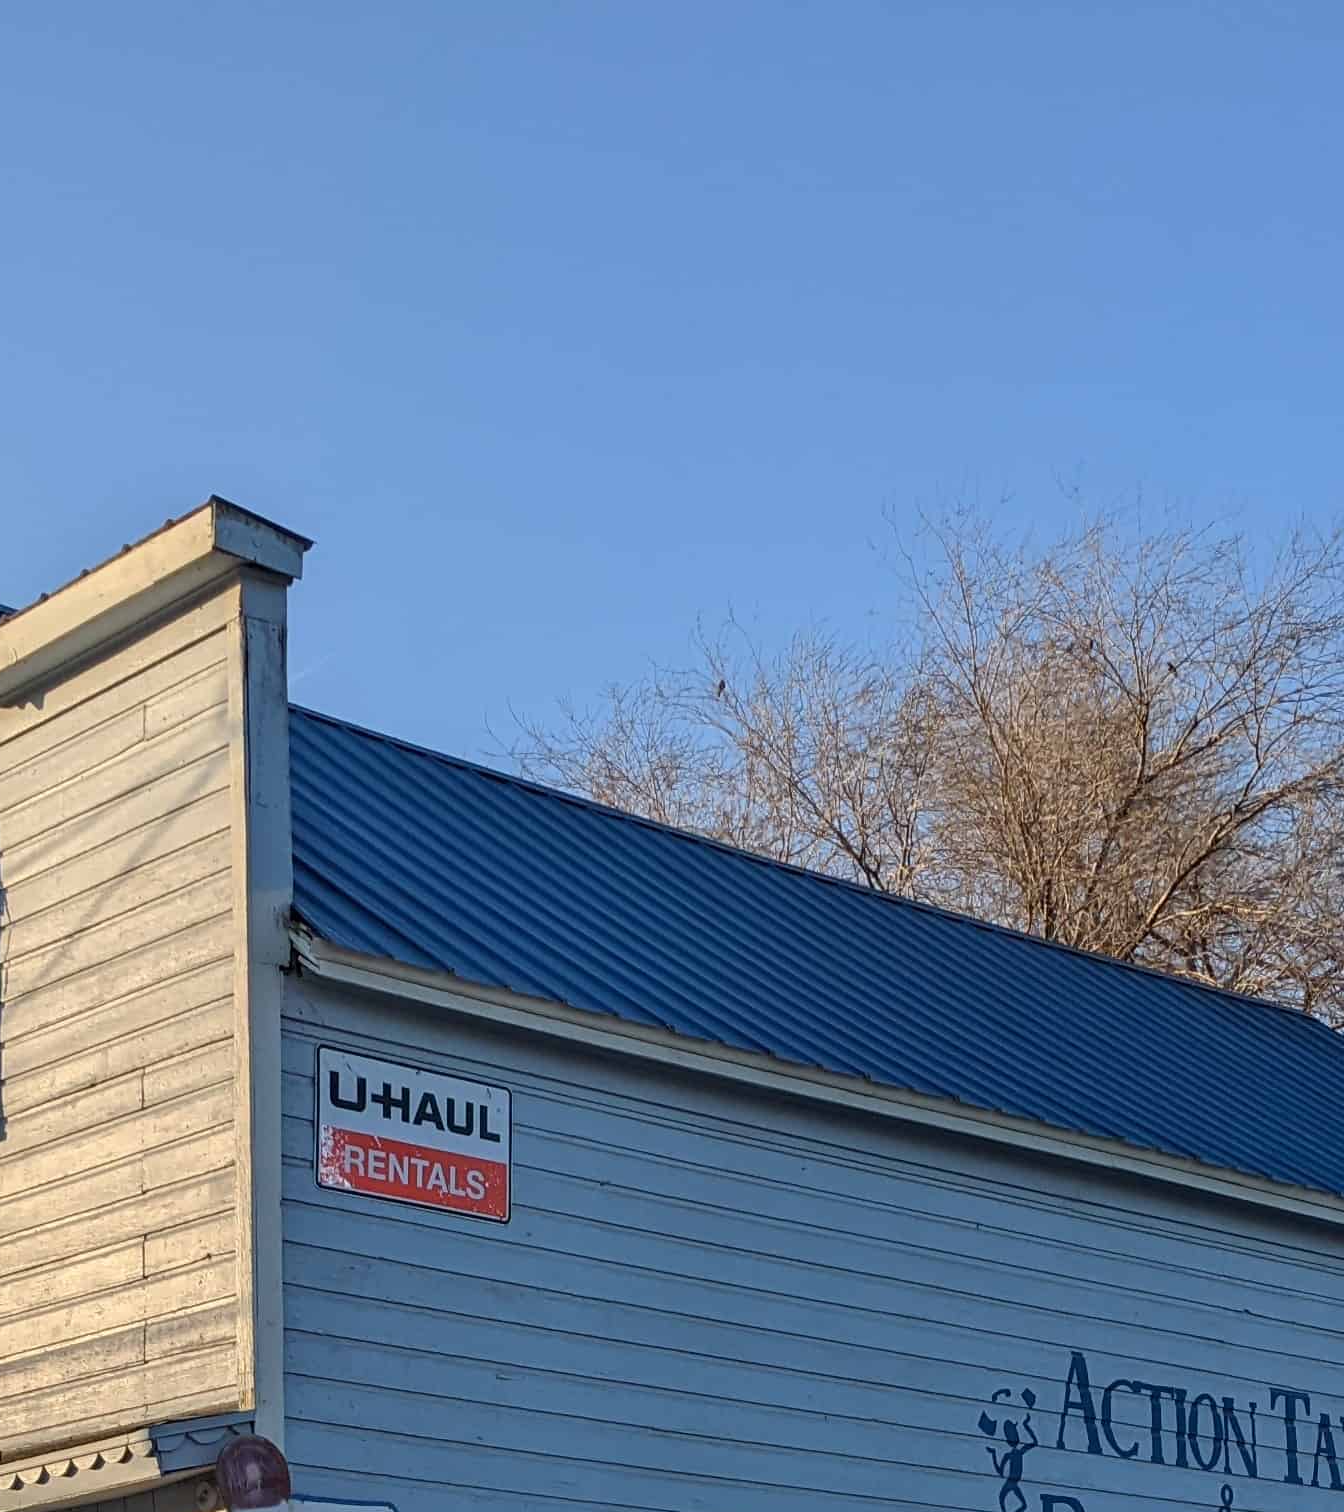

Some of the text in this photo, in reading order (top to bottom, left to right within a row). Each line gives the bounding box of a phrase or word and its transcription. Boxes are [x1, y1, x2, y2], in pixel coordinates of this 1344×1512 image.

[329, 1070, 501, 1143] U-HAUL
[343, 1144, 486, 1200] RENTALS
[1056, 1351, 1258, 1478] ACTION
